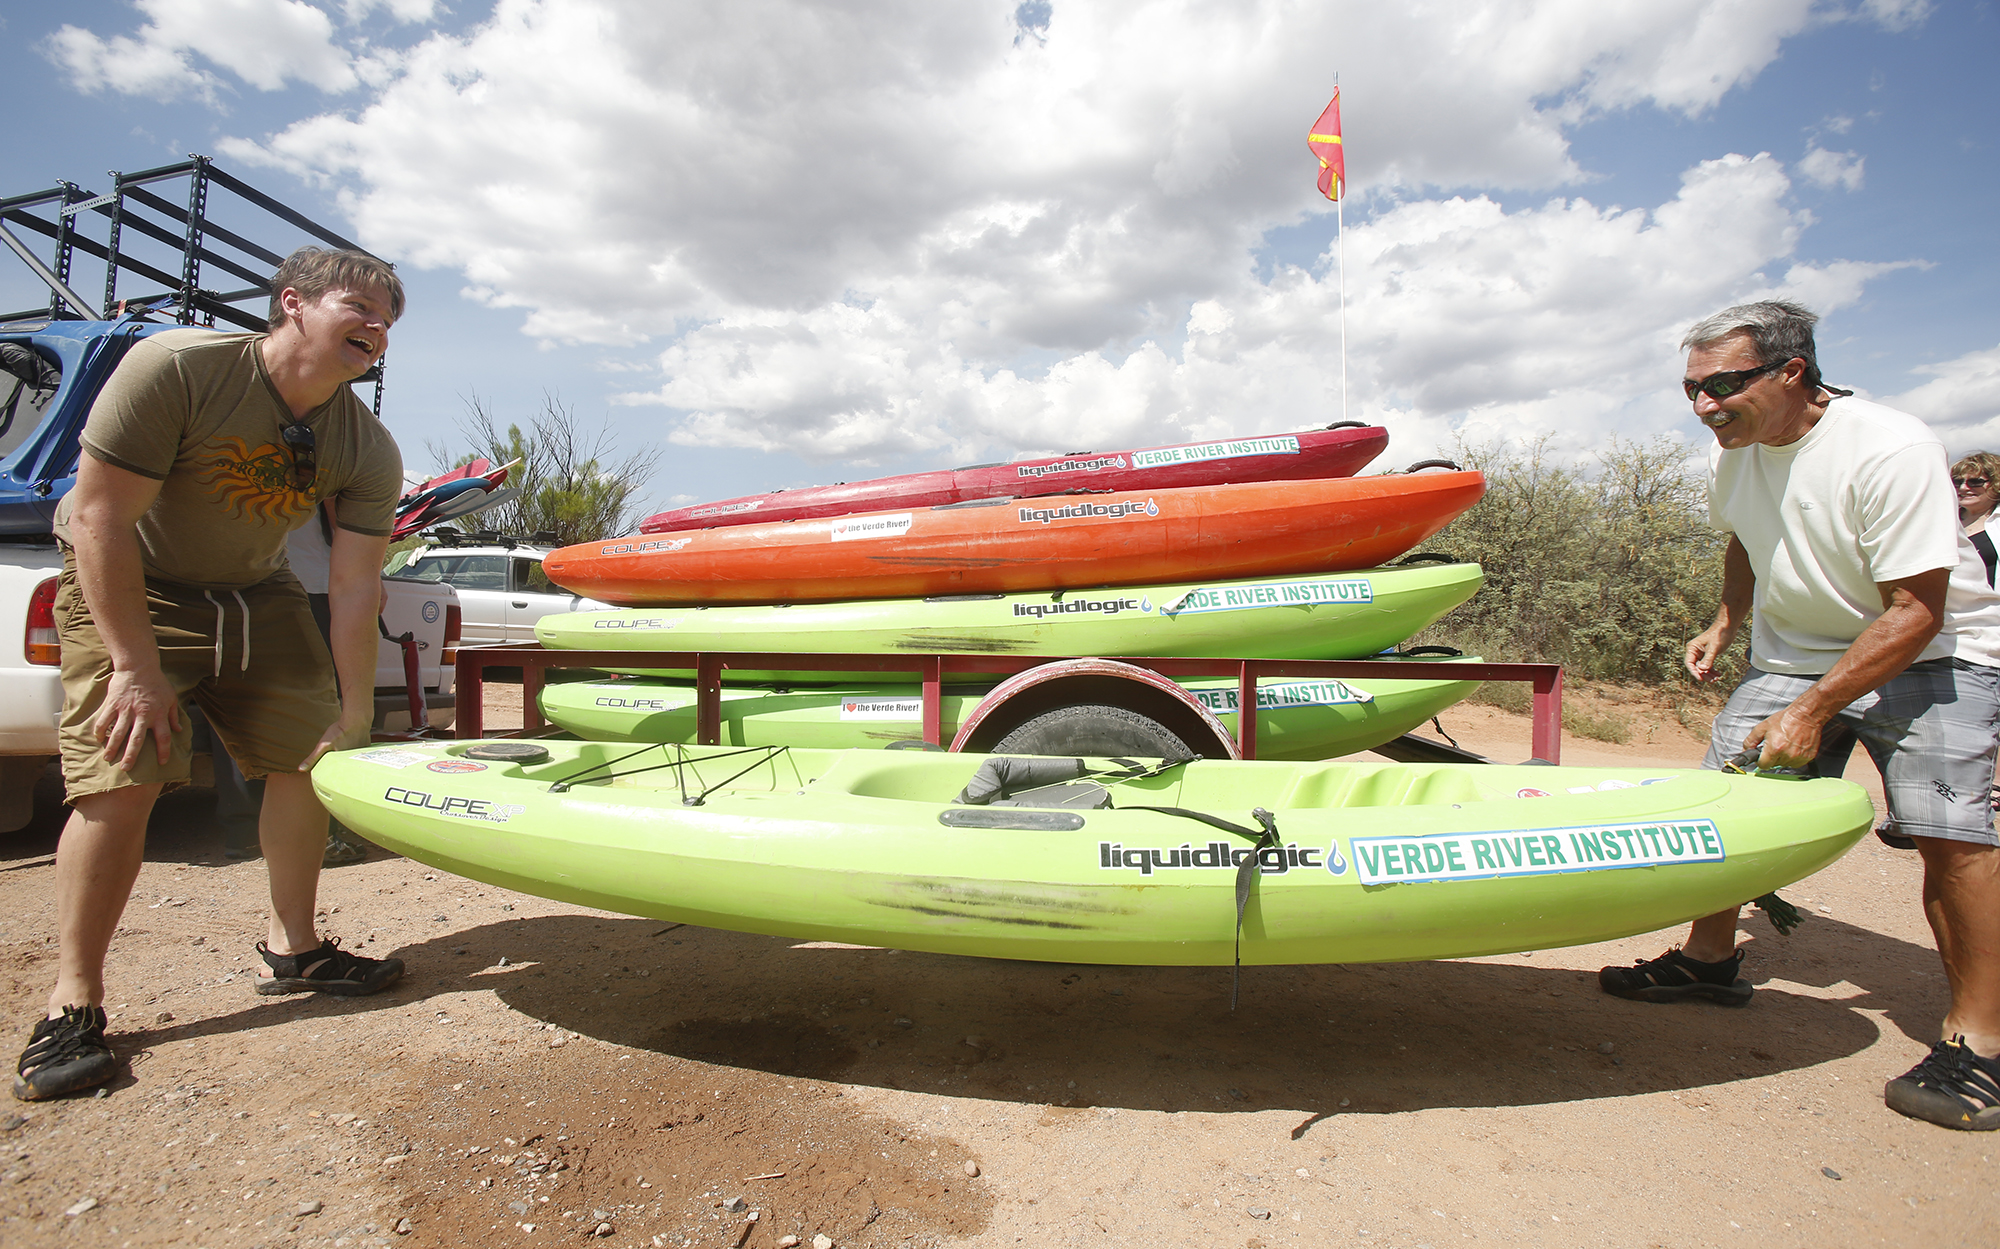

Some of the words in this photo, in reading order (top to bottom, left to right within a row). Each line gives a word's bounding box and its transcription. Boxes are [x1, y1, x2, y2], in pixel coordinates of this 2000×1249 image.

[1135, 449, 1181, 465] VERDE
[1186, 444, 1226, 459] RIVER
[1228, 438, 1297, 454] INSTITUTE
[1018, 457, 1116, 477] liquidlogic
[1019, 501, 1145, 523] liquidlogic
[862, 522, 885, 531] Verde
[886, 519, 909, 528] River!
[601, 540, 670, 555] COUPE
[1225, 588, 1279, 606] RIVER
[1281, 583, 1370, 602] INSTITUTE
[1013, 598, 1138, 618] liquidlogic
[594, 618, 662, 628] COUPE
[595, 697, 664, 709] COUPE
[1282, 683, 1349, 704] INSTITU
[384, 786, 493, 816] COUPE
[1099, 844, 1324, 875] liquidlogic
[1358, 840, 1466, 877] VERDE
[1468, 834, 1568, 870] RIVER
[1569, 824, 1720, 863] INSTITUTE
